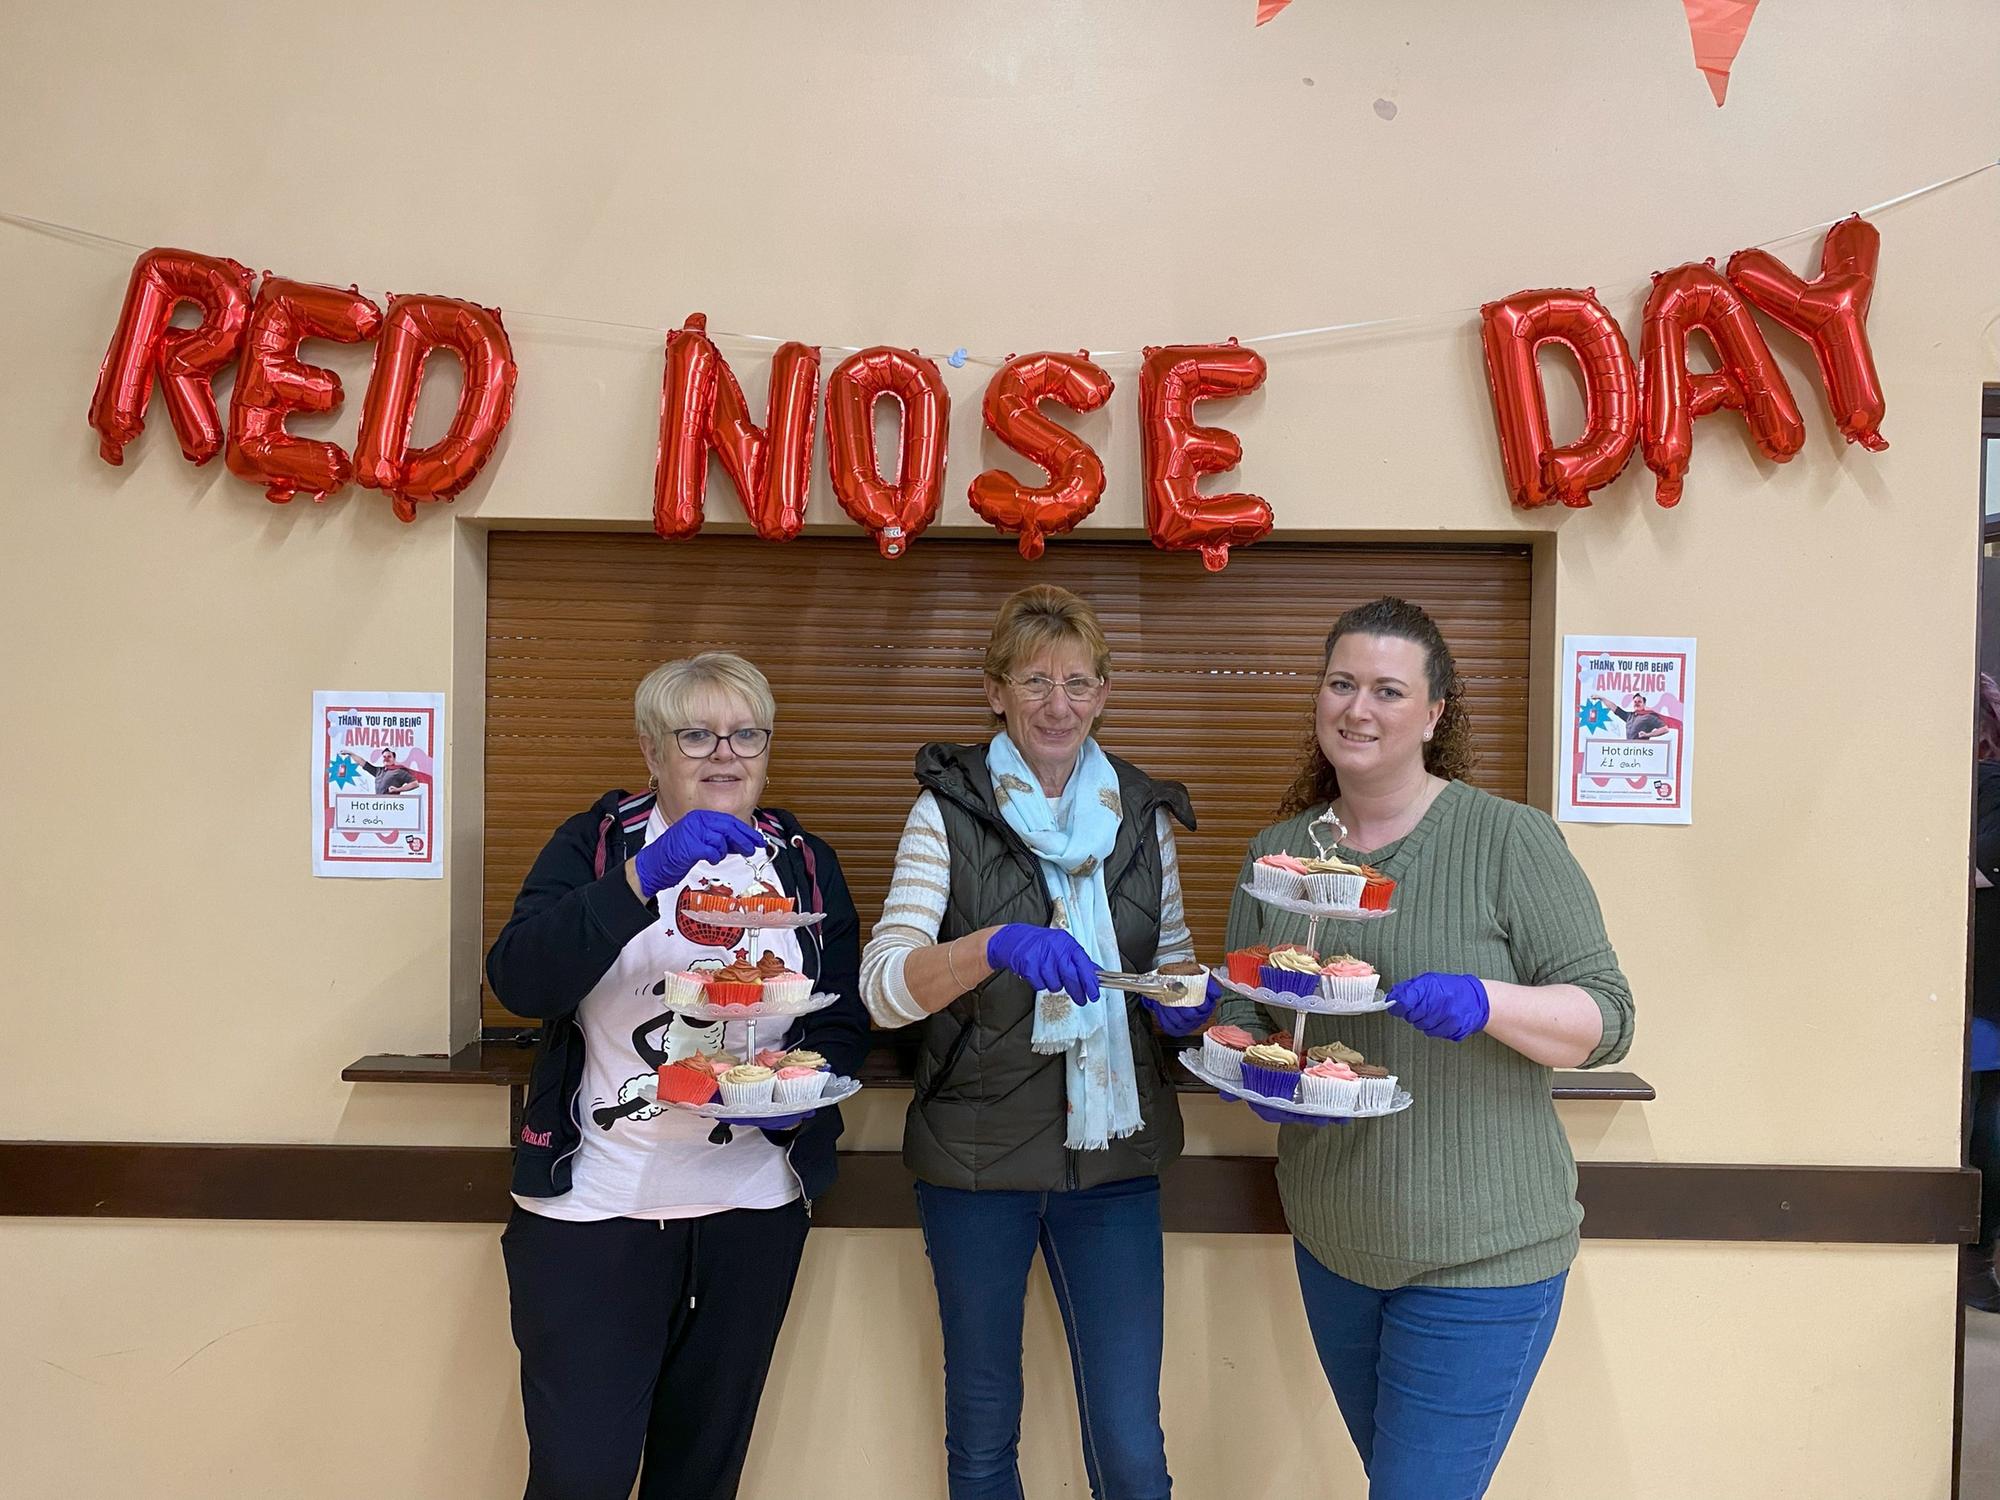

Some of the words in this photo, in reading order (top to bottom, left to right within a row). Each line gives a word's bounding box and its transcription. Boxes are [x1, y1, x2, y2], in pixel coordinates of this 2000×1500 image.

[88, 247, 518, 520] RED
[653, 312, 1275, 571] NOSE
[1480, 213, 1889, 508] DAY
[1590, 660, 1615, 672] THANK
[1618, 660, 1632, 671] YOU
[1635, 661, 1649, 671] FOR
[1651, 661, 1674, 673] BEING
[1596, 672, 1666, 693] AMAZING
[338, 715, 362, 727] THANK
[366, 715, 380, 726] YOU
[383, 716, 397, 727] FOR
[399, 716, 422, 728] BEING
[344, 727, 414, 748] AMAZING
[1602, 746, 1621, 755] Hot
[1623, 746, 1654, 756] drinks
[1620, 758, 1641, 768] each
[351, 801, 371, 811] Hot
[372, 801, 405, 811] drinks
